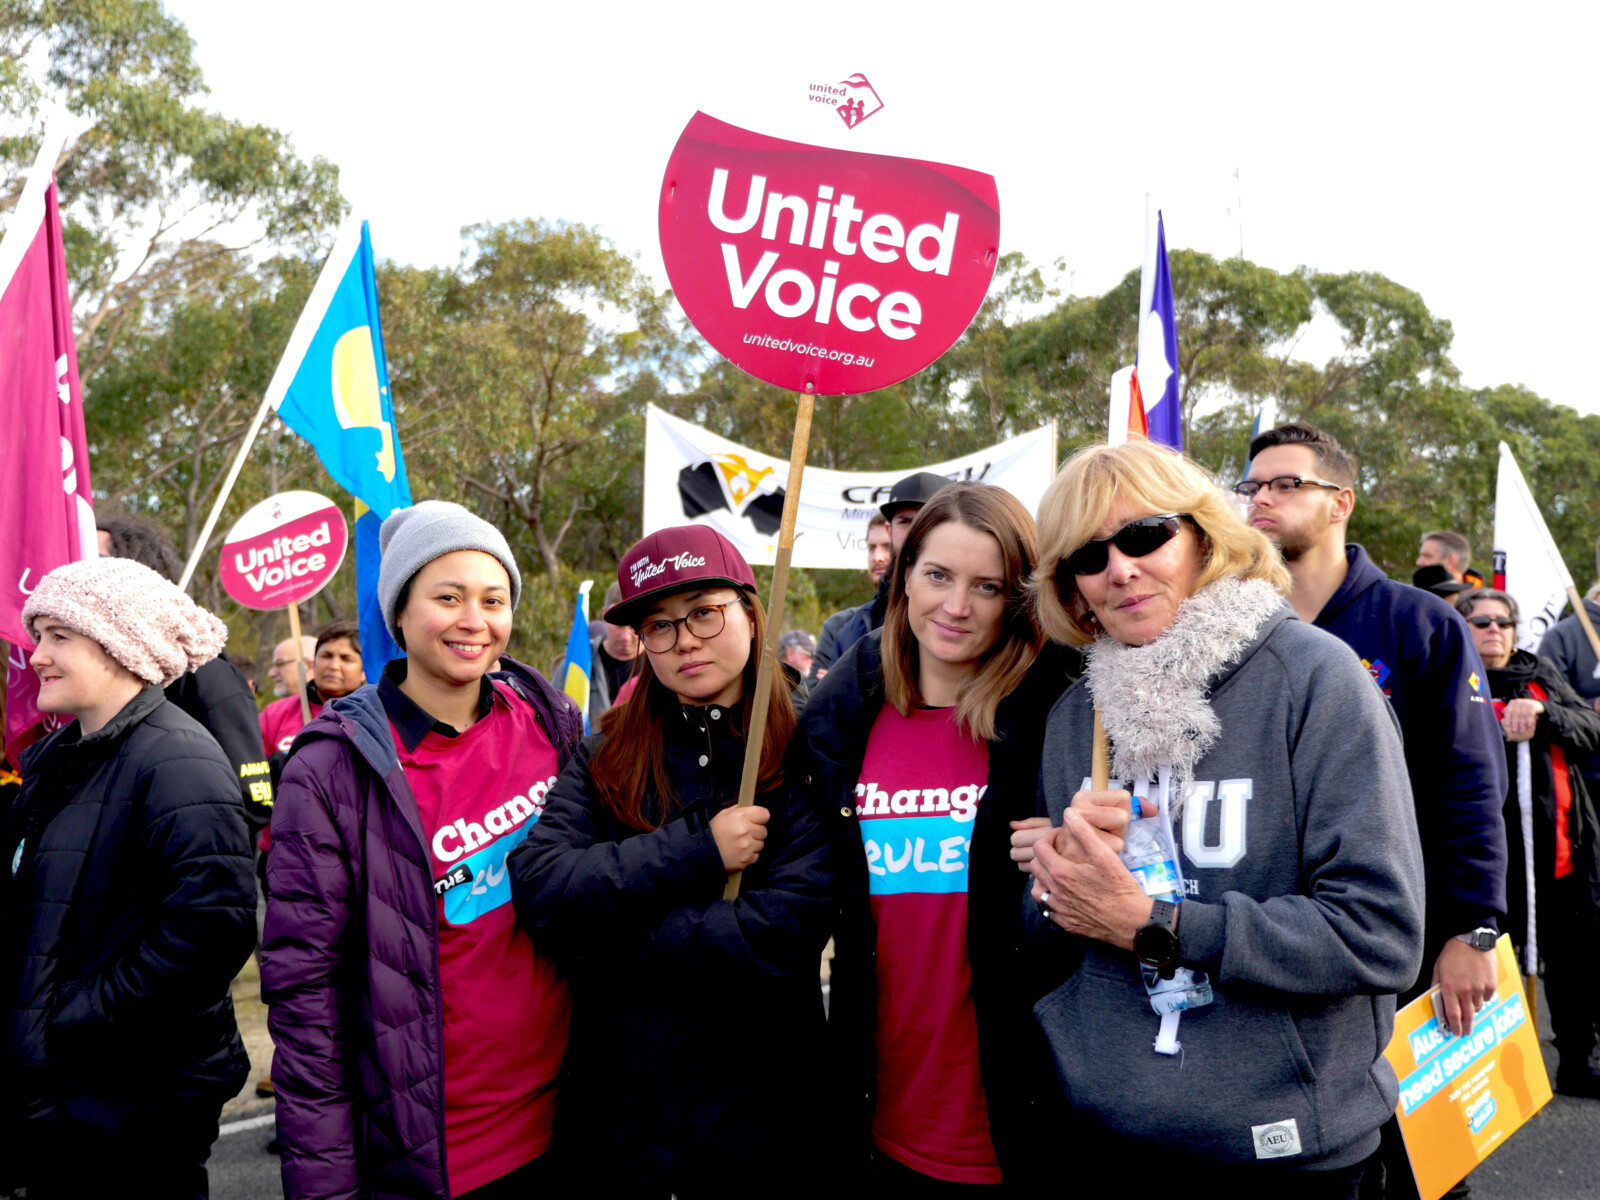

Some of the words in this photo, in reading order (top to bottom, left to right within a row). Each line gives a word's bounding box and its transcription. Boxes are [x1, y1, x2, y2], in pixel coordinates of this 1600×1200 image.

[808, 94, 838, 106] voice
[809, 83, 847, 97] united
[707, 167, 960, 277] United
[720, 242, 922, 341] Voice
[743, 332, 876, 368] unitedvoice.org.au
[235, 522, 331, 574] United
[245, 553, 327, 592] Voice
[631, 558, 668, 588] United
[667, 551, 706, 571] Voice
[854, 783, 988, 822] hang
[865, 836, 970, 876] RULE
[434, 869, 466, 894] THE
[1399, 1060, 1443, 1111] need
[1442, 1026, 1494, 1077] secure
[1491, 1002, 1526, 1045] jobs
[1266, 1134, 1287, 1145] AEU
